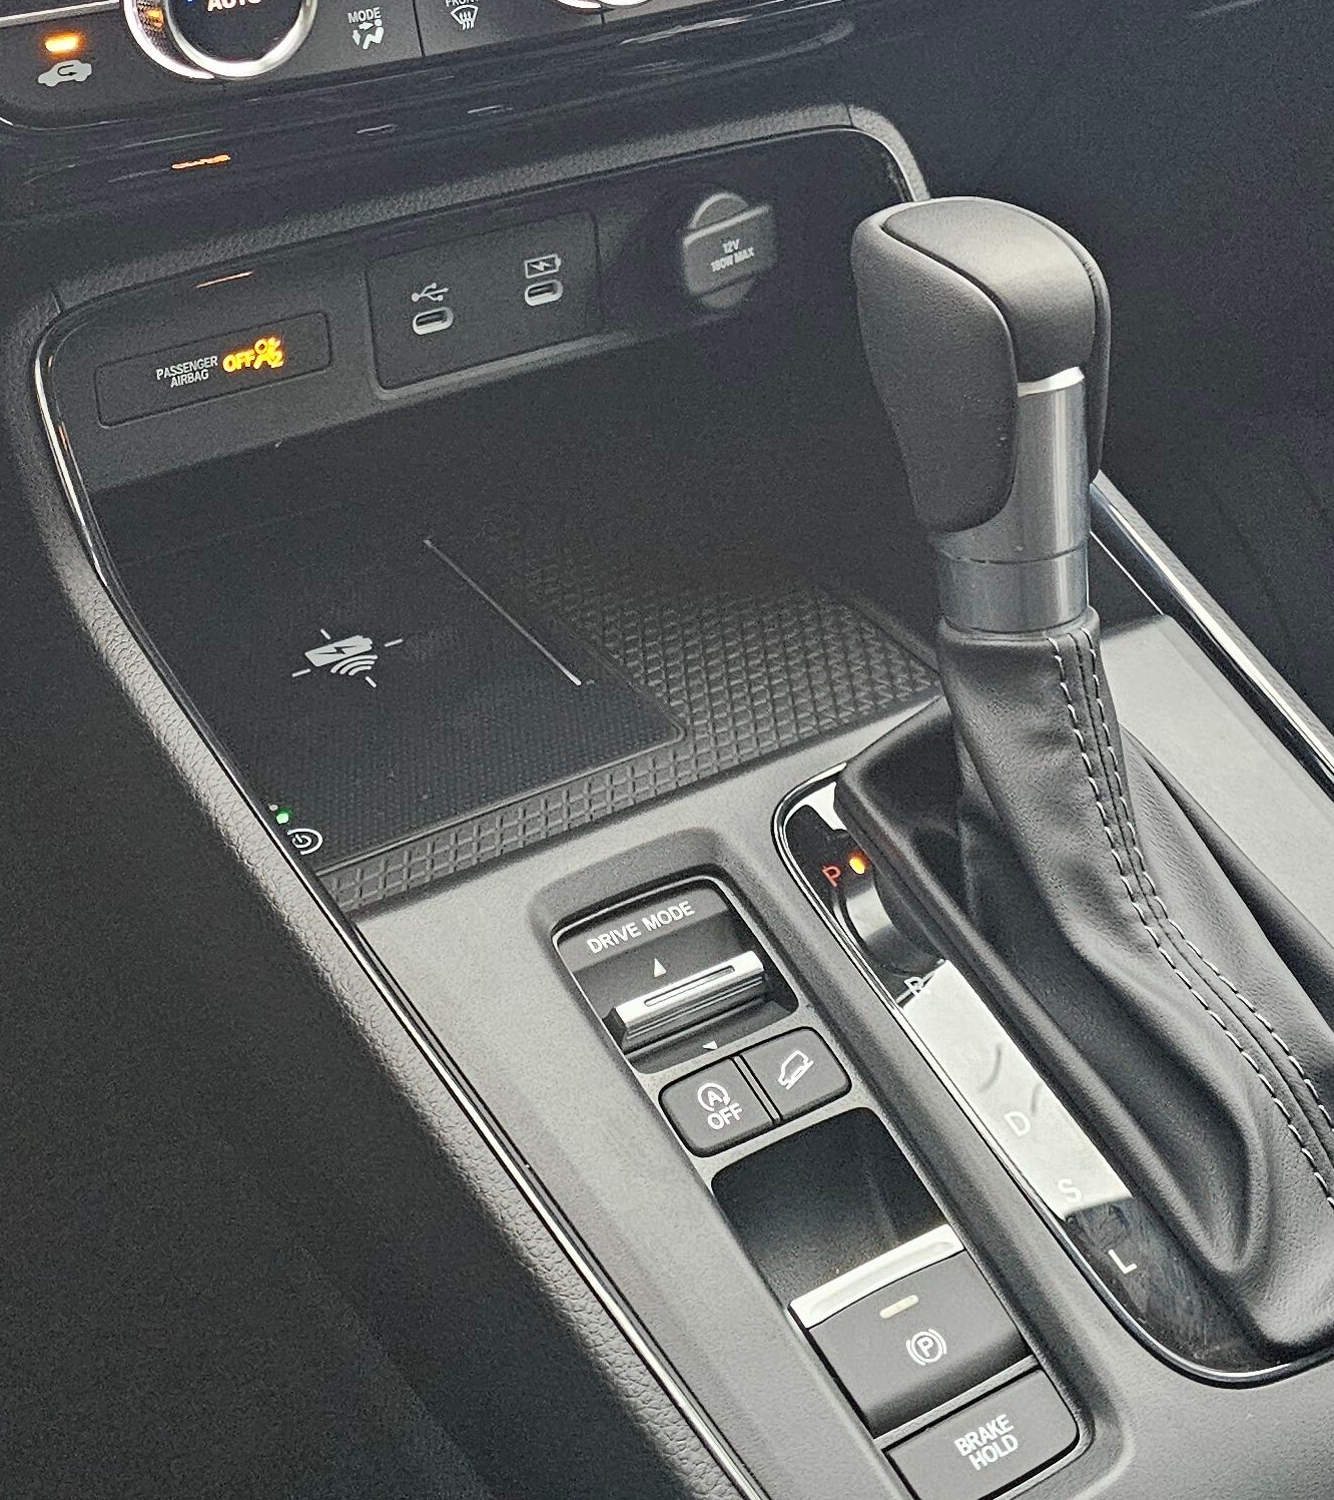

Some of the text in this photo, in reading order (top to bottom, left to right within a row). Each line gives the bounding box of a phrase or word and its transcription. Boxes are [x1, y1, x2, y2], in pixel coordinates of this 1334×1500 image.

[348, 6, 381, 25] MODE
[155, 355, 218, 380] PASSENGER
[222, 349, 255, 373] OFF
[170, 369, 209, 388] AIRBAG
[821, 864, 841, 888] P
[586, 899, 695, 955] DRIVE MODE
[706, 1100, 743, 1131] OFF
[1004, 1111, 1032, 1138] D
[1057, 1177, 1083, 1204] S
[1107, 1248, 1137, 1276] L
[954, 1414, 1014, 1458] BRAKE
[969, 1431, 1019, 1470] HOLD
